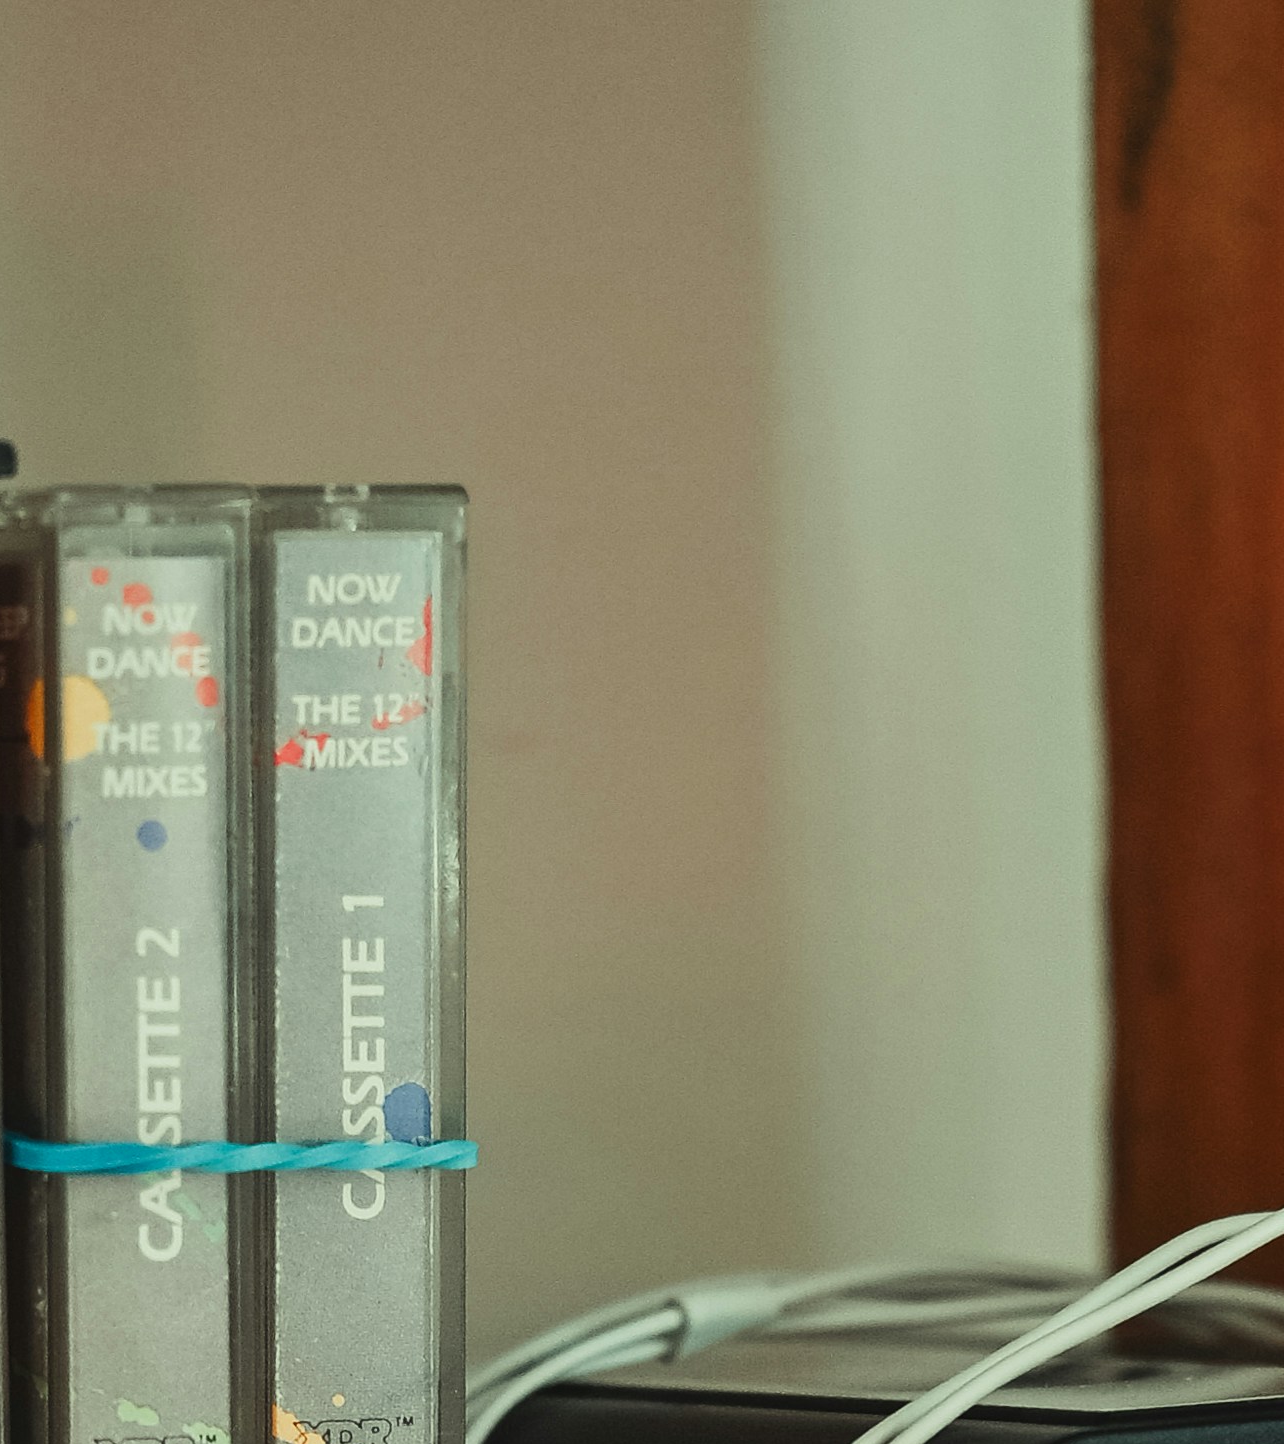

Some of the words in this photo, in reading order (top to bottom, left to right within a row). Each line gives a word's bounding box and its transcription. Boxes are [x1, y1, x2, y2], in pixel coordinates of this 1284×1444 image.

[307, 573, 402, 605] NOW
[101, 603, 197, 636] NOW
[292, 616, 415, 648] DANCE
[87, 647, 212, 680] DANCE
[293, 694, 362, 726] THE
[93, 721, 161, 755] THE
[304, 736, 409, 769] MIXES
[102, 765, 209, 799] MIXES
[342, 895, 385, 912] 1
[135, 927, 181, 958] 2
[342, 938, 386, 1220] CSSETTE
[137, 976, 183, 1262] CASETTE
